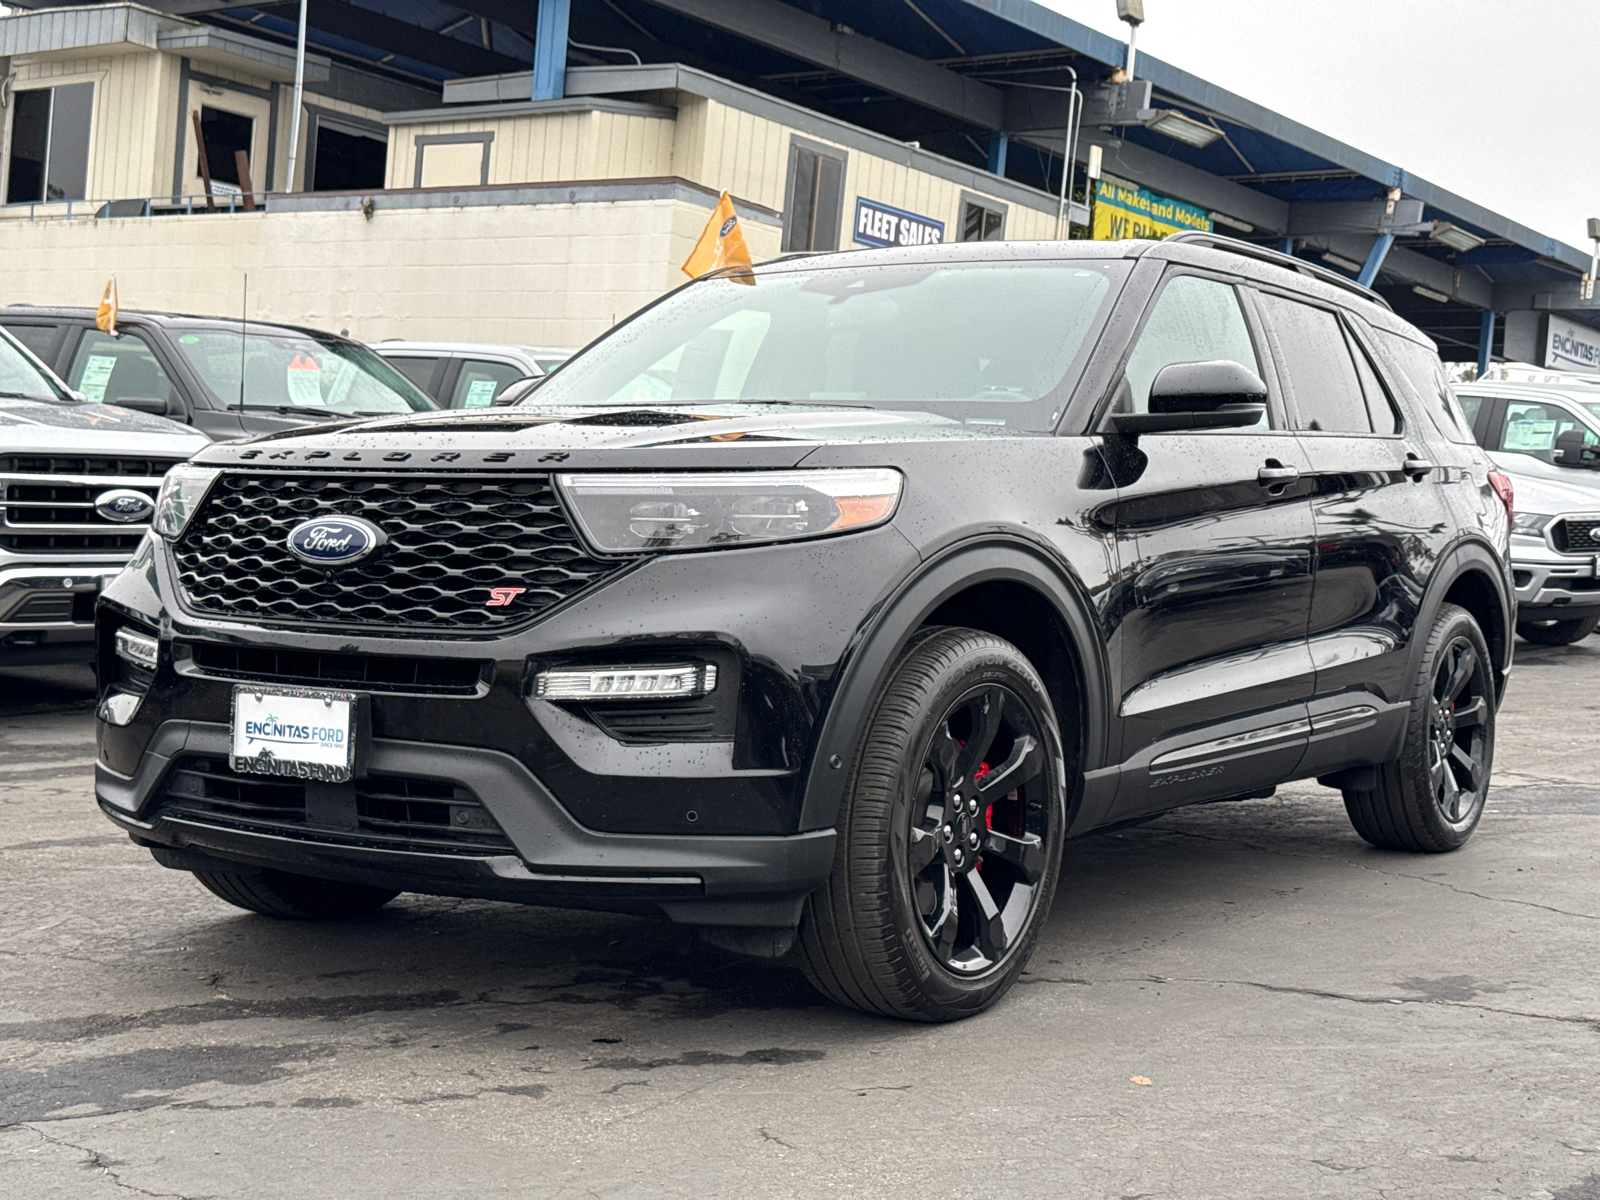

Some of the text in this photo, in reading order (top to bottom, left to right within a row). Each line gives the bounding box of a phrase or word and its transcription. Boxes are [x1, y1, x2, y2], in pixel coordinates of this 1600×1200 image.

[1099, 181, 1210, 232] All Makes and Models
[858, 206, 941, 246] FLEET SALES
[239, 450, 570, 462] EXPLORER
[303, 526, 353, 552] Ford
[485, 587, 526, 606] ST
[1008, 661, 1040, 692] ZERO
[245, 720, 344, 743] ENCINITAS FORD
[1149, 766, 1226, 788] EXPLORER
